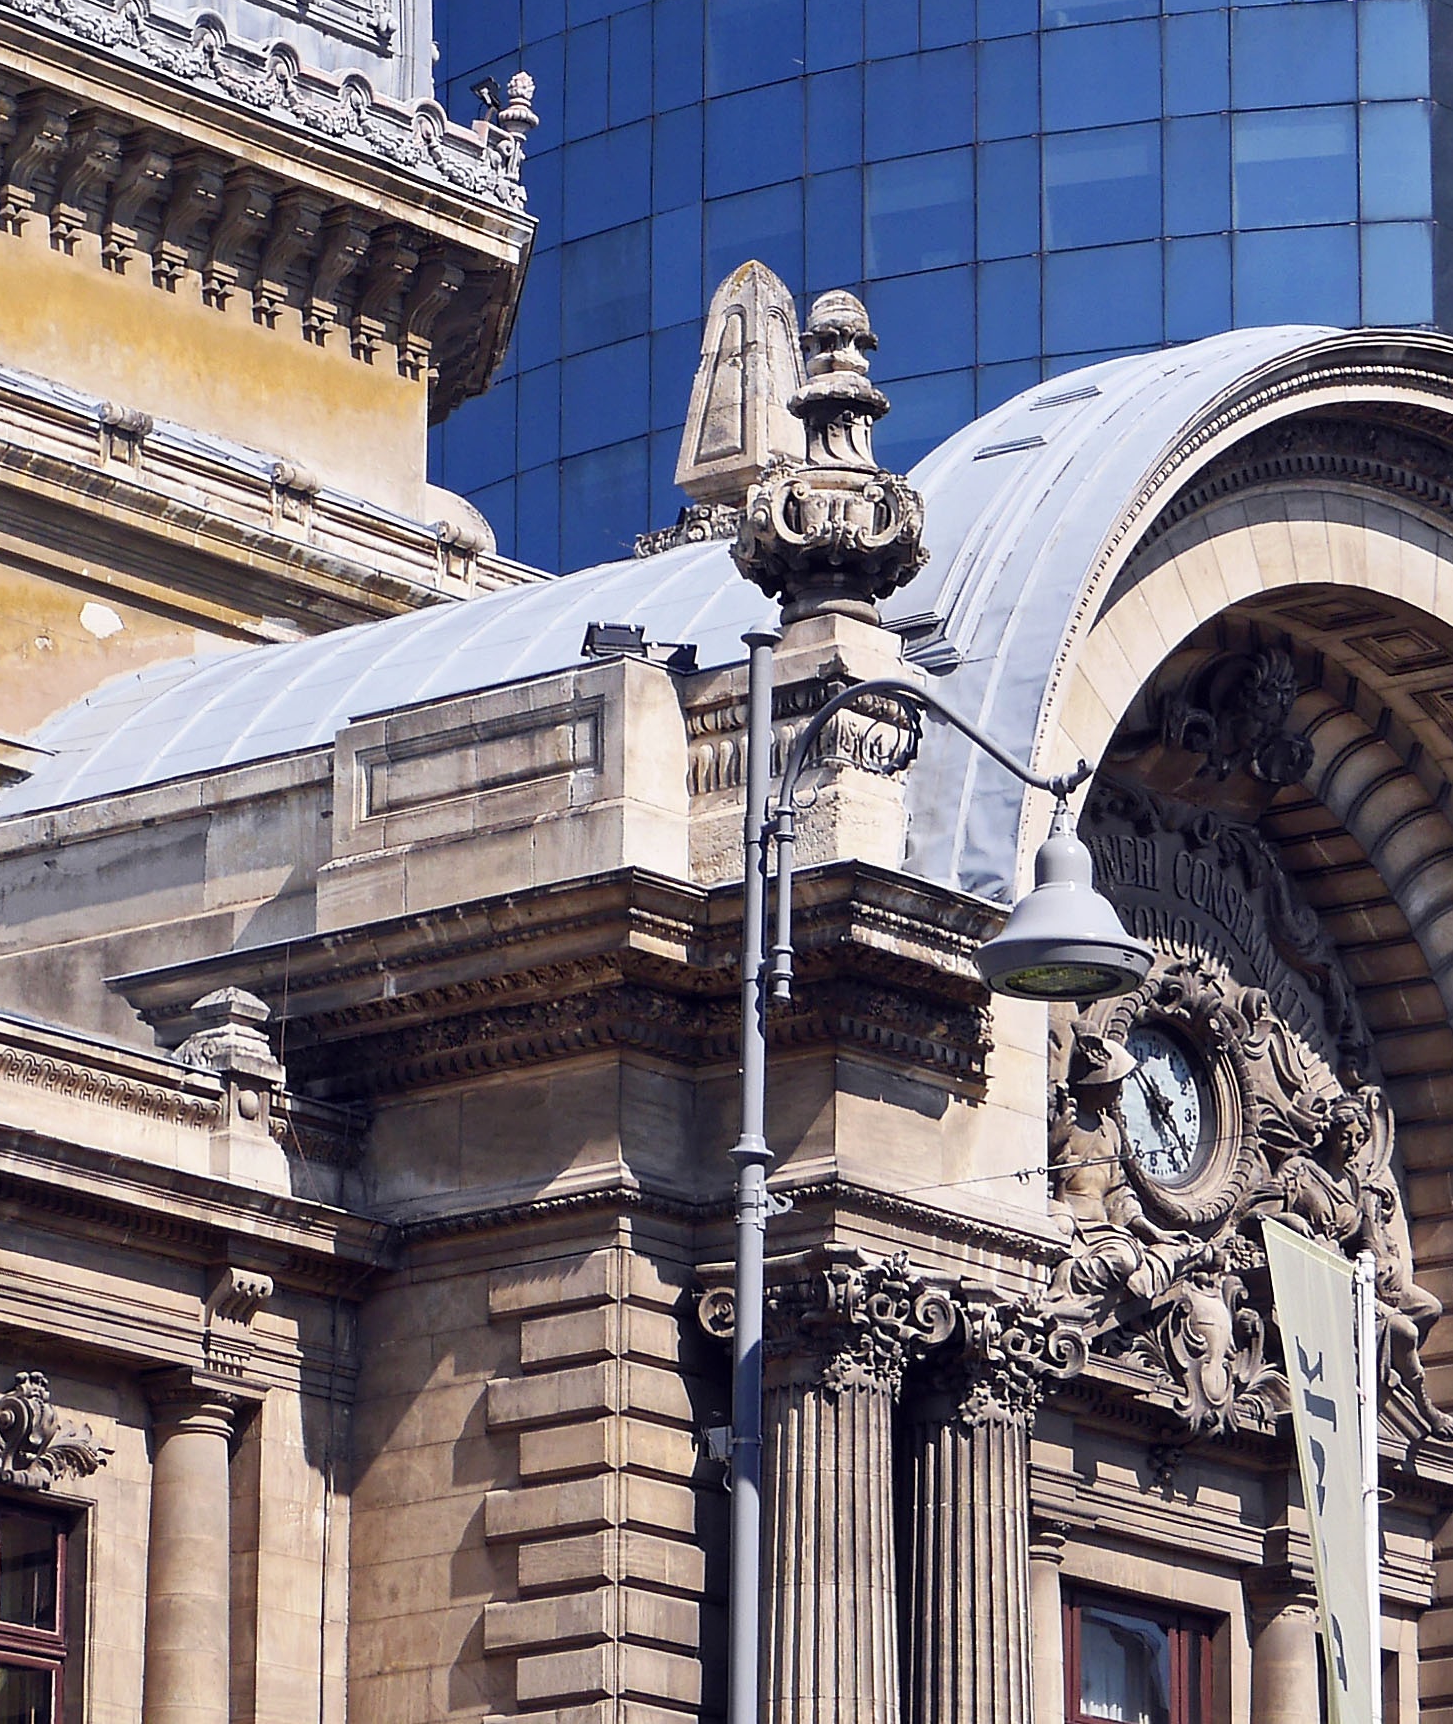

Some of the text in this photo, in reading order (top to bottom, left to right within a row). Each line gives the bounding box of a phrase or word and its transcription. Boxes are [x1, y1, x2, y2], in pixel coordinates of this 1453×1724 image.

[1148, 1042, 1161, 1060] 12
[1180, 1082, 1188, 1096] 2
[1184, 1108, 1192, 1124] 3
[1149, 1152, 1158, 1167] 6
